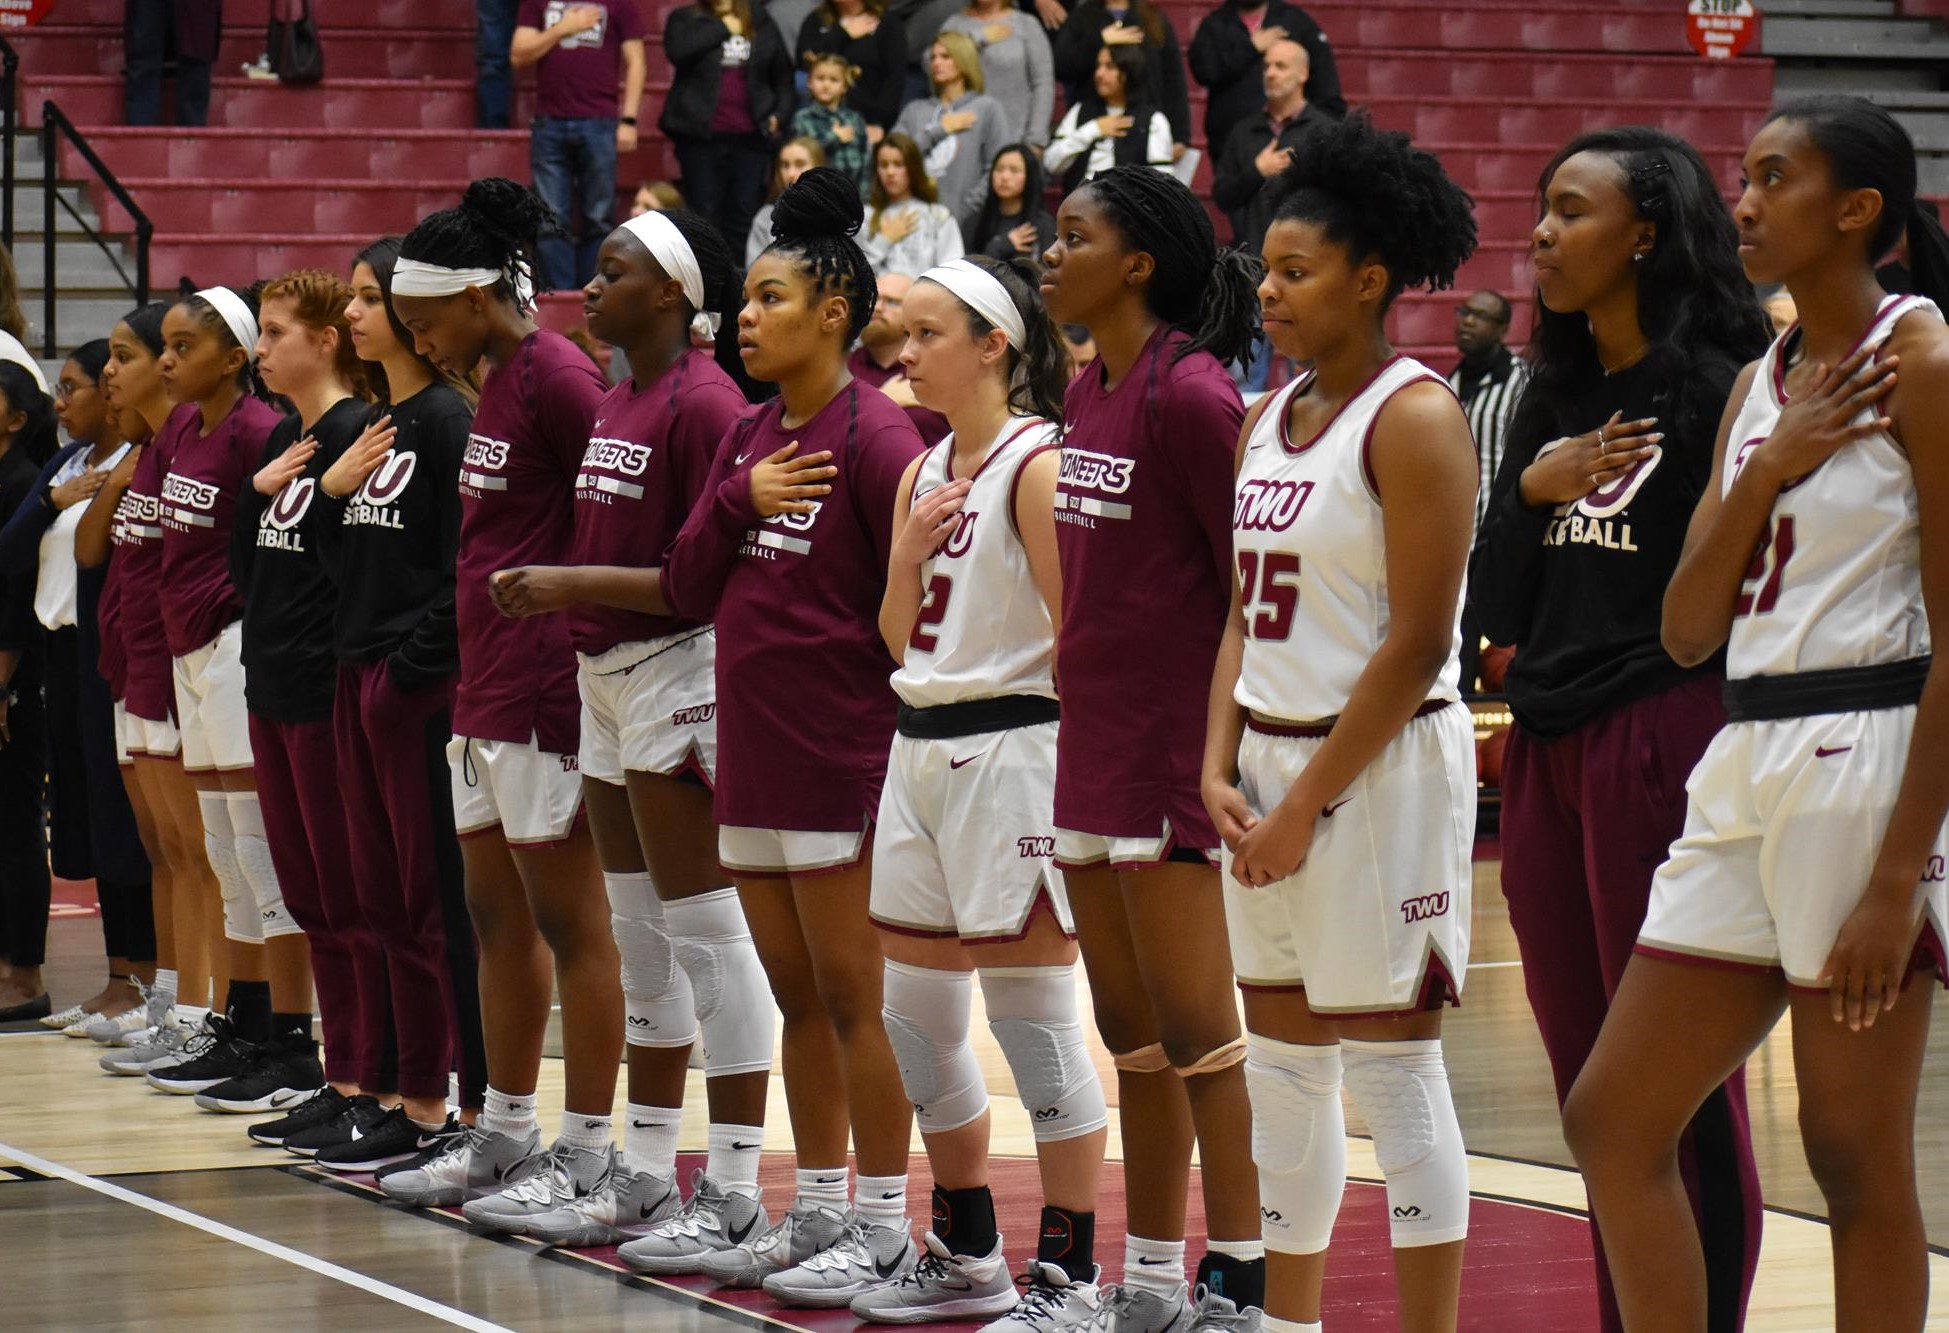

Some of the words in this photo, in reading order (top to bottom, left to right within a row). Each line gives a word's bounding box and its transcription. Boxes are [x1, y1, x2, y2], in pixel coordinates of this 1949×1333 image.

[1233, 478, 1316, 532] TWU
[909, 571, 954, 655] 2
[672, 702, 717, 727] TWU
[1400, 890, 1450, 924] TWU
